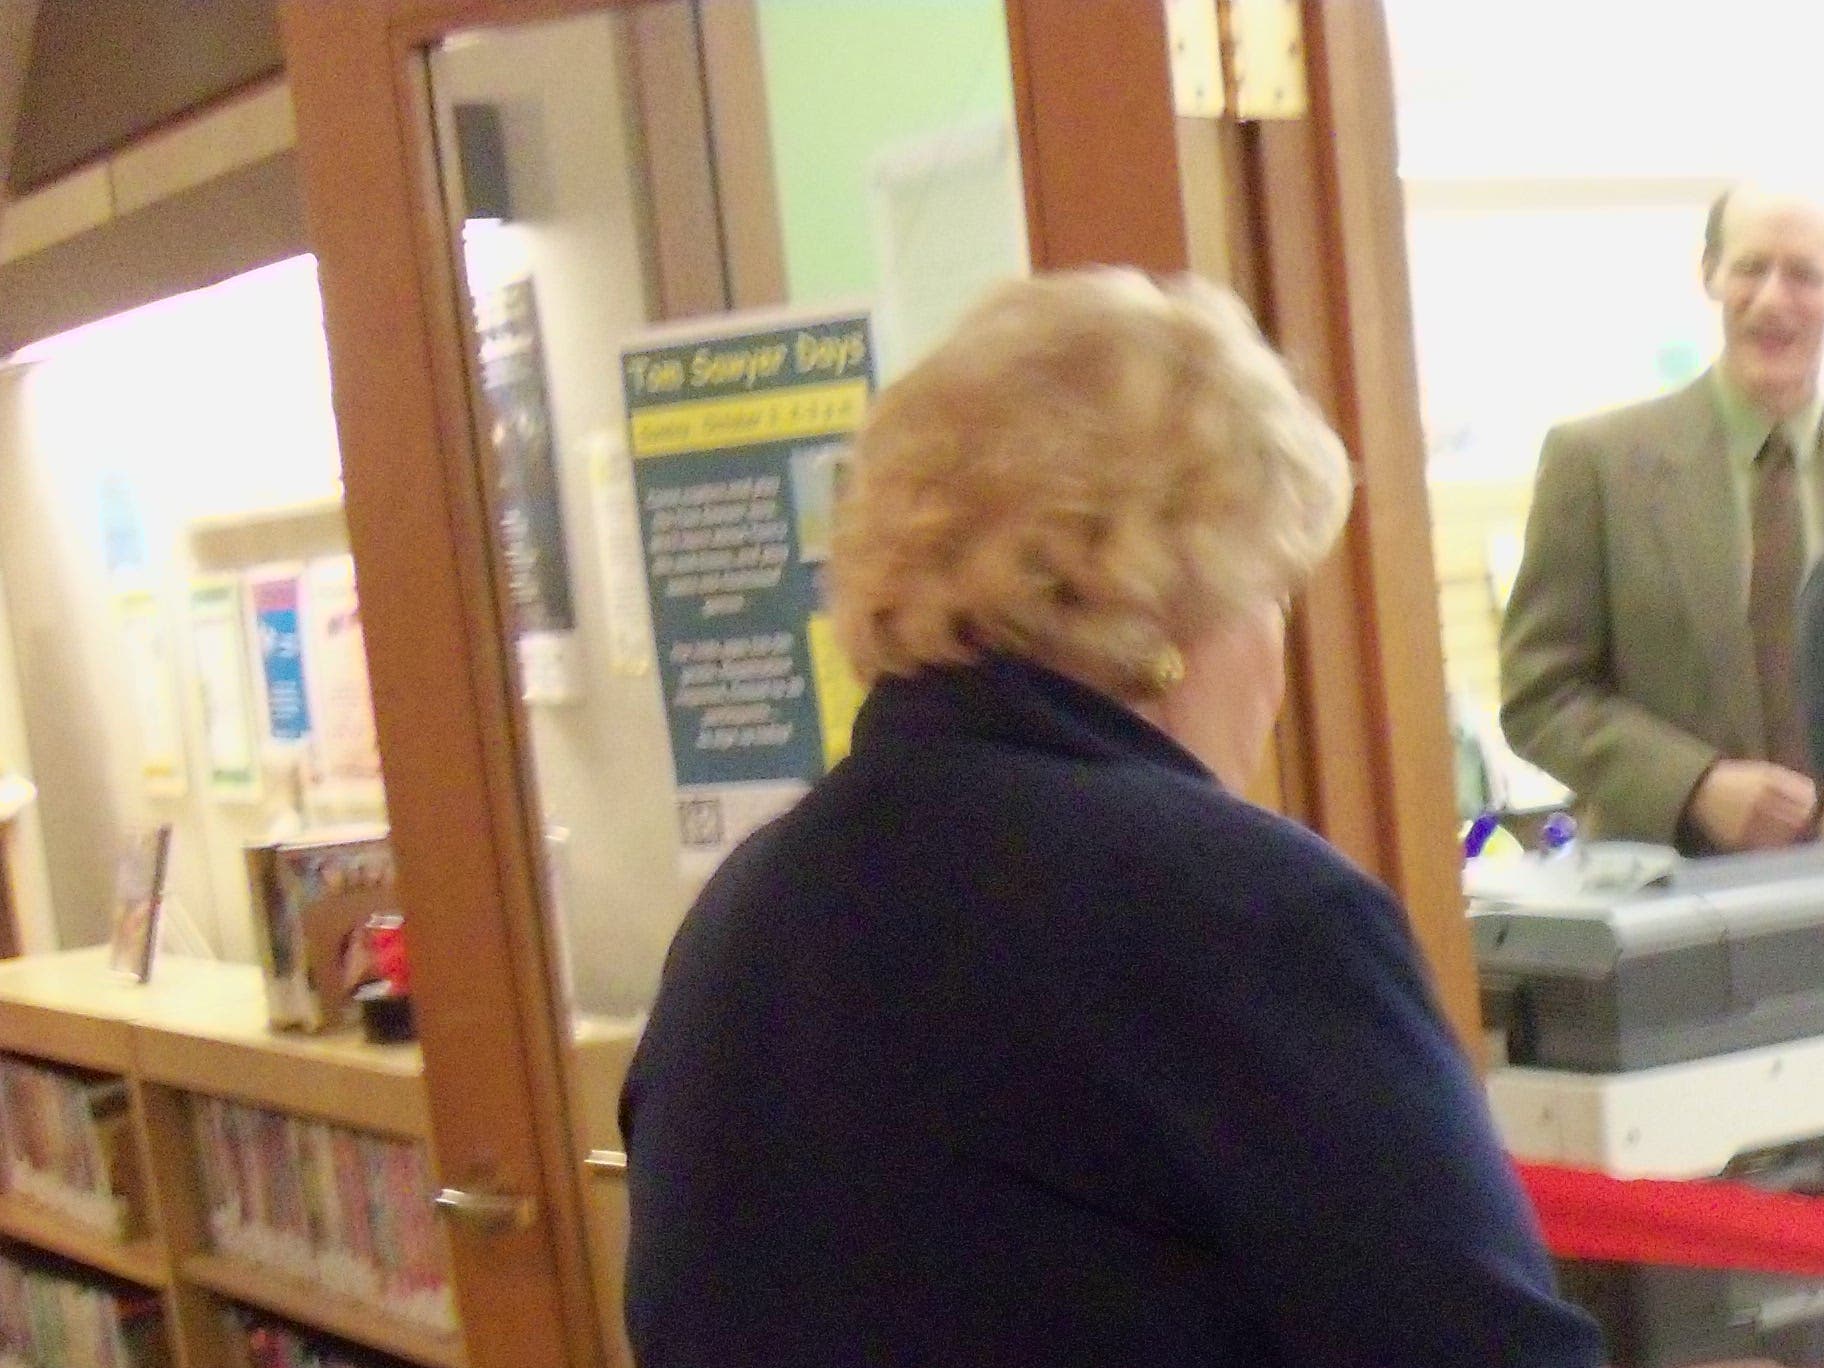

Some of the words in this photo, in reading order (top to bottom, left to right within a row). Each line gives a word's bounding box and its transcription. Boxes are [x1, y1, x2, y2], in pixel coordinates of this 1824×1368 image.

[629, 356, 685, 394] Tom
[691, 346, 787, 388] Sawyer
[796, 331, 866, 376] Days
